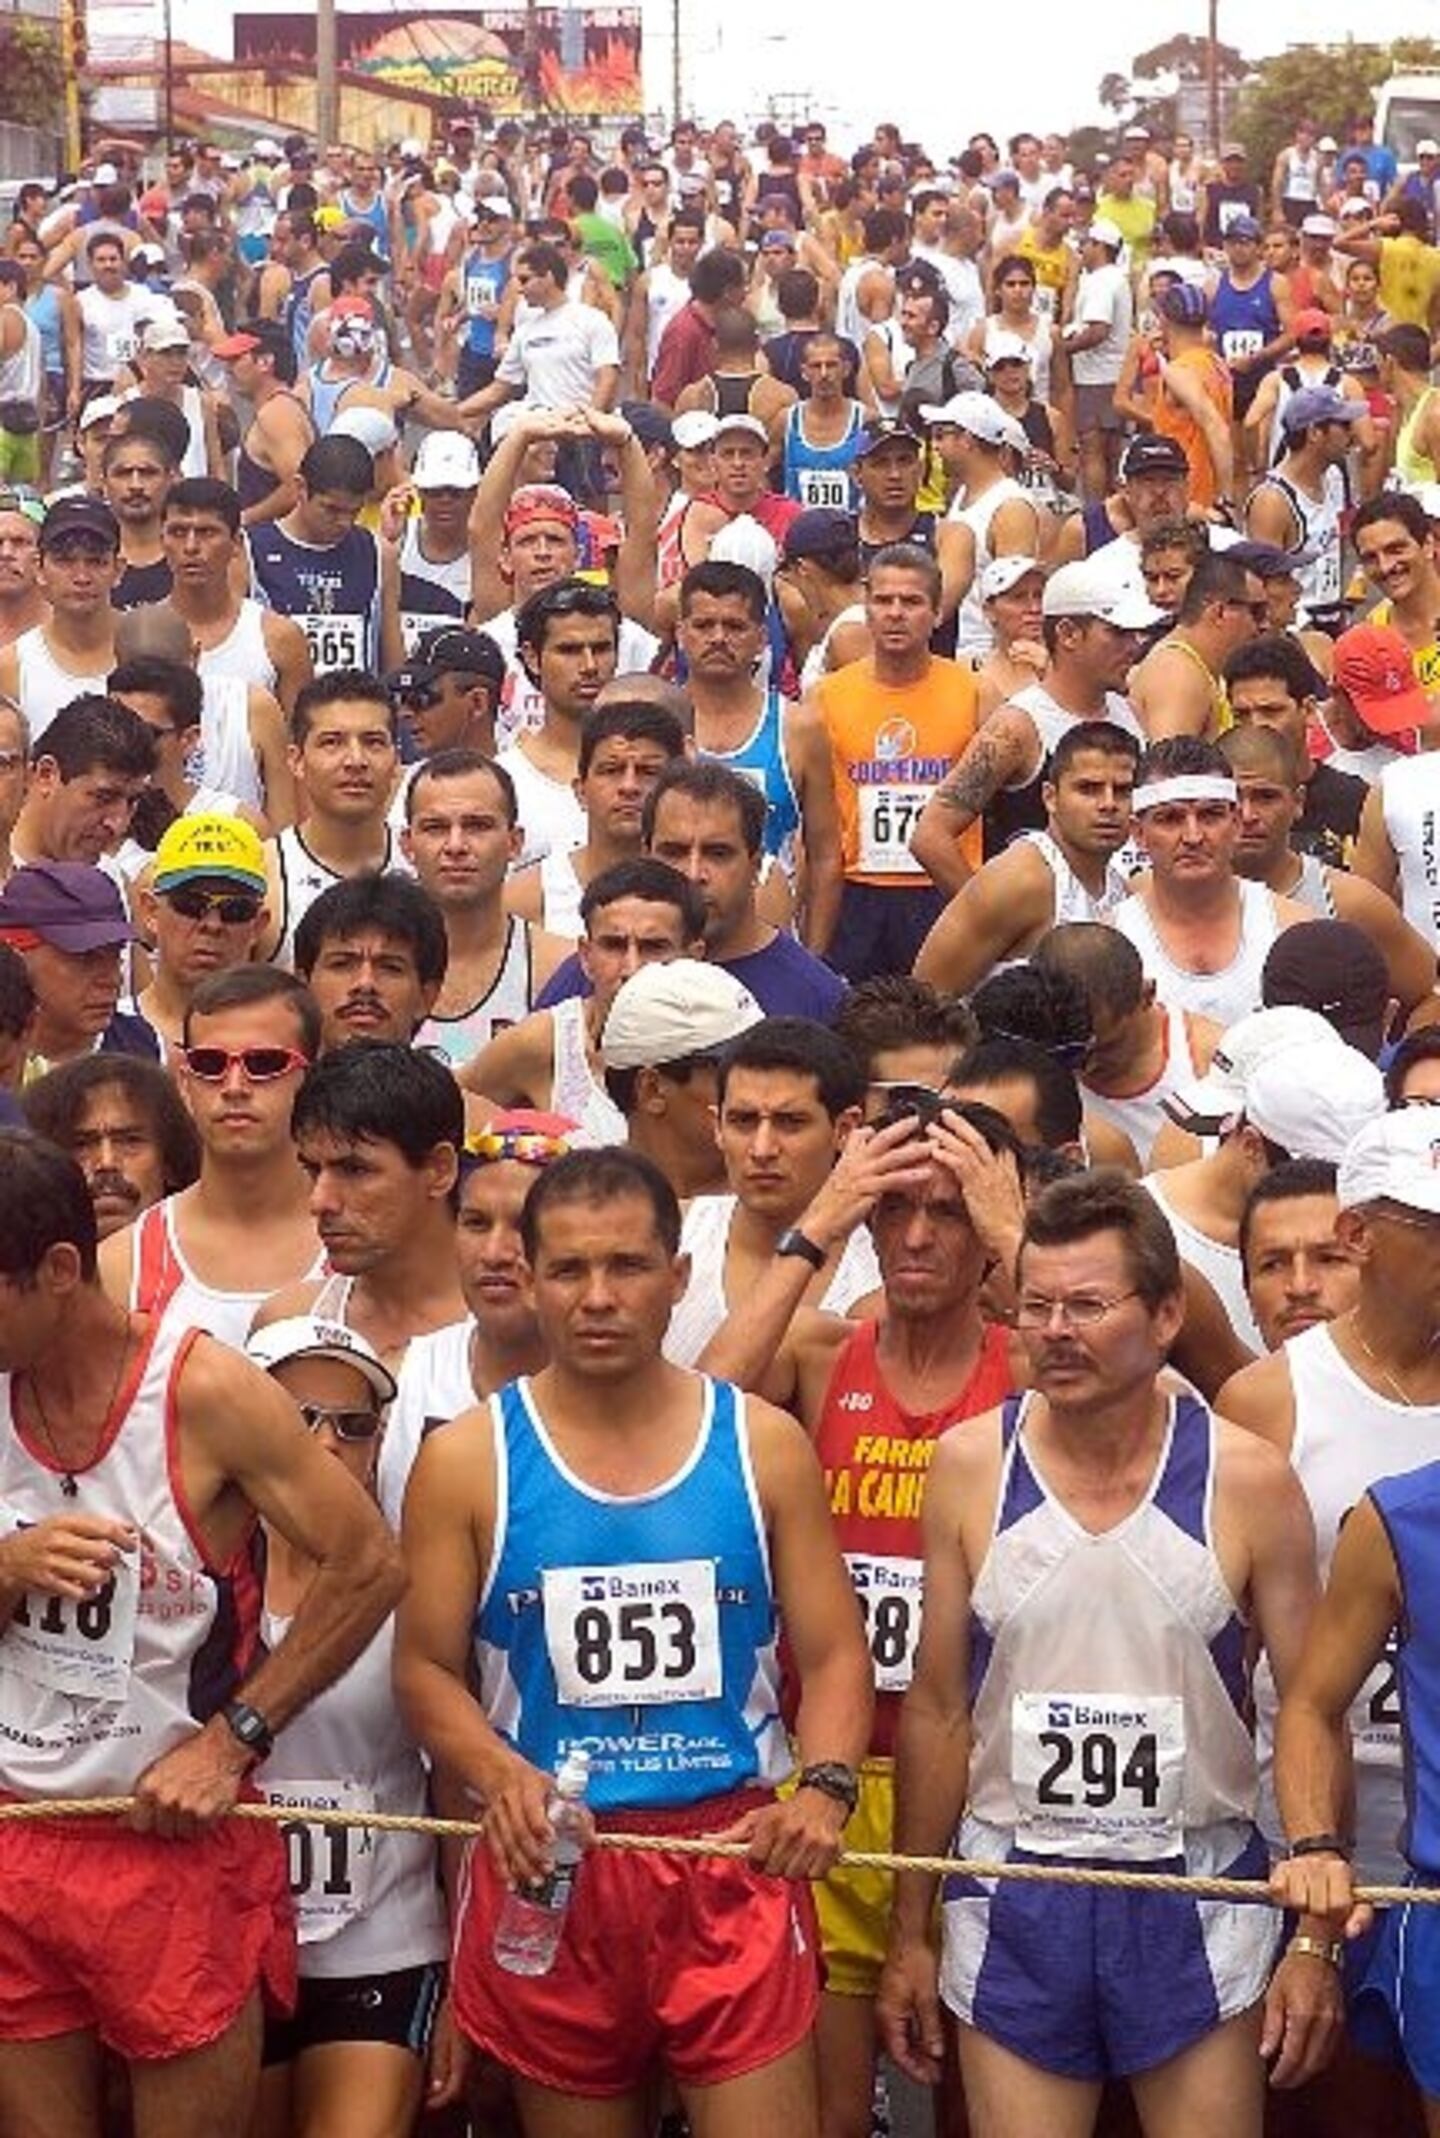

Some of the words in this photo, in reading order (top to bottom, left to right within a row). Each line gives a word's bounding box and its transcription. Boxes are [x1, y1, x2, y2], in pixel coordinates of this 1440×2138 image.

[808, 484, 842, 505] 830
[873, 804, 926, 843] 67
[609, 1576, 680, 1599] Banex
[573, 1602, 697, 1685] 853
[1074, 1706, 1148, 1728] Banex
[1037, 1731, 1160, 1808] 294
[269, 1794, 342, 1810] Banex
